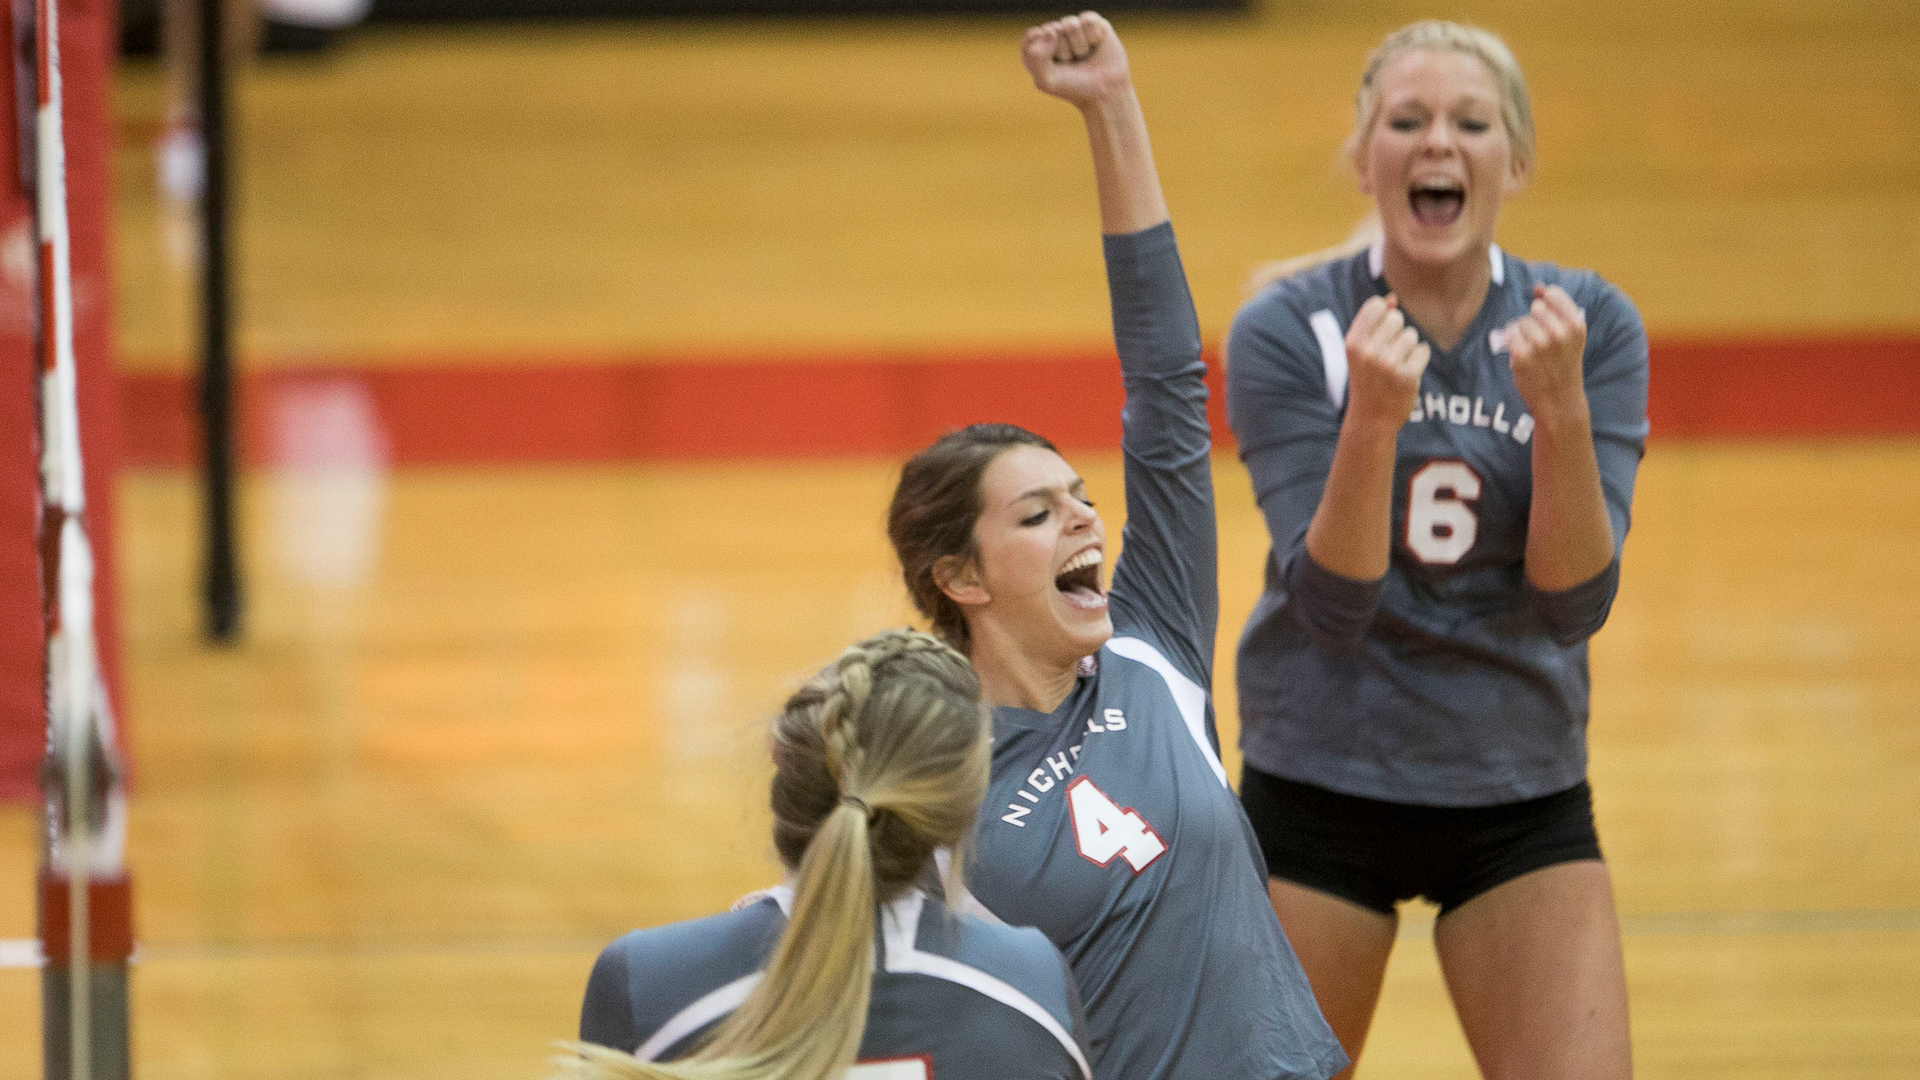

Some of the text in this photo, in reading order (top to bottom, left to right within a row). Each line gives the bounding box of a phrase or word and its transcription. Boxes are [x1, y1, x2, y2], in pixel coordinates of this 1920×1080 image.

[1408, 391, 1535, 445] HOLLS
[1404, 457, 1482, 565] 6
[1001, 708, 1127, 828] NICHLS
[1065, 774, 1169, 876] 4
